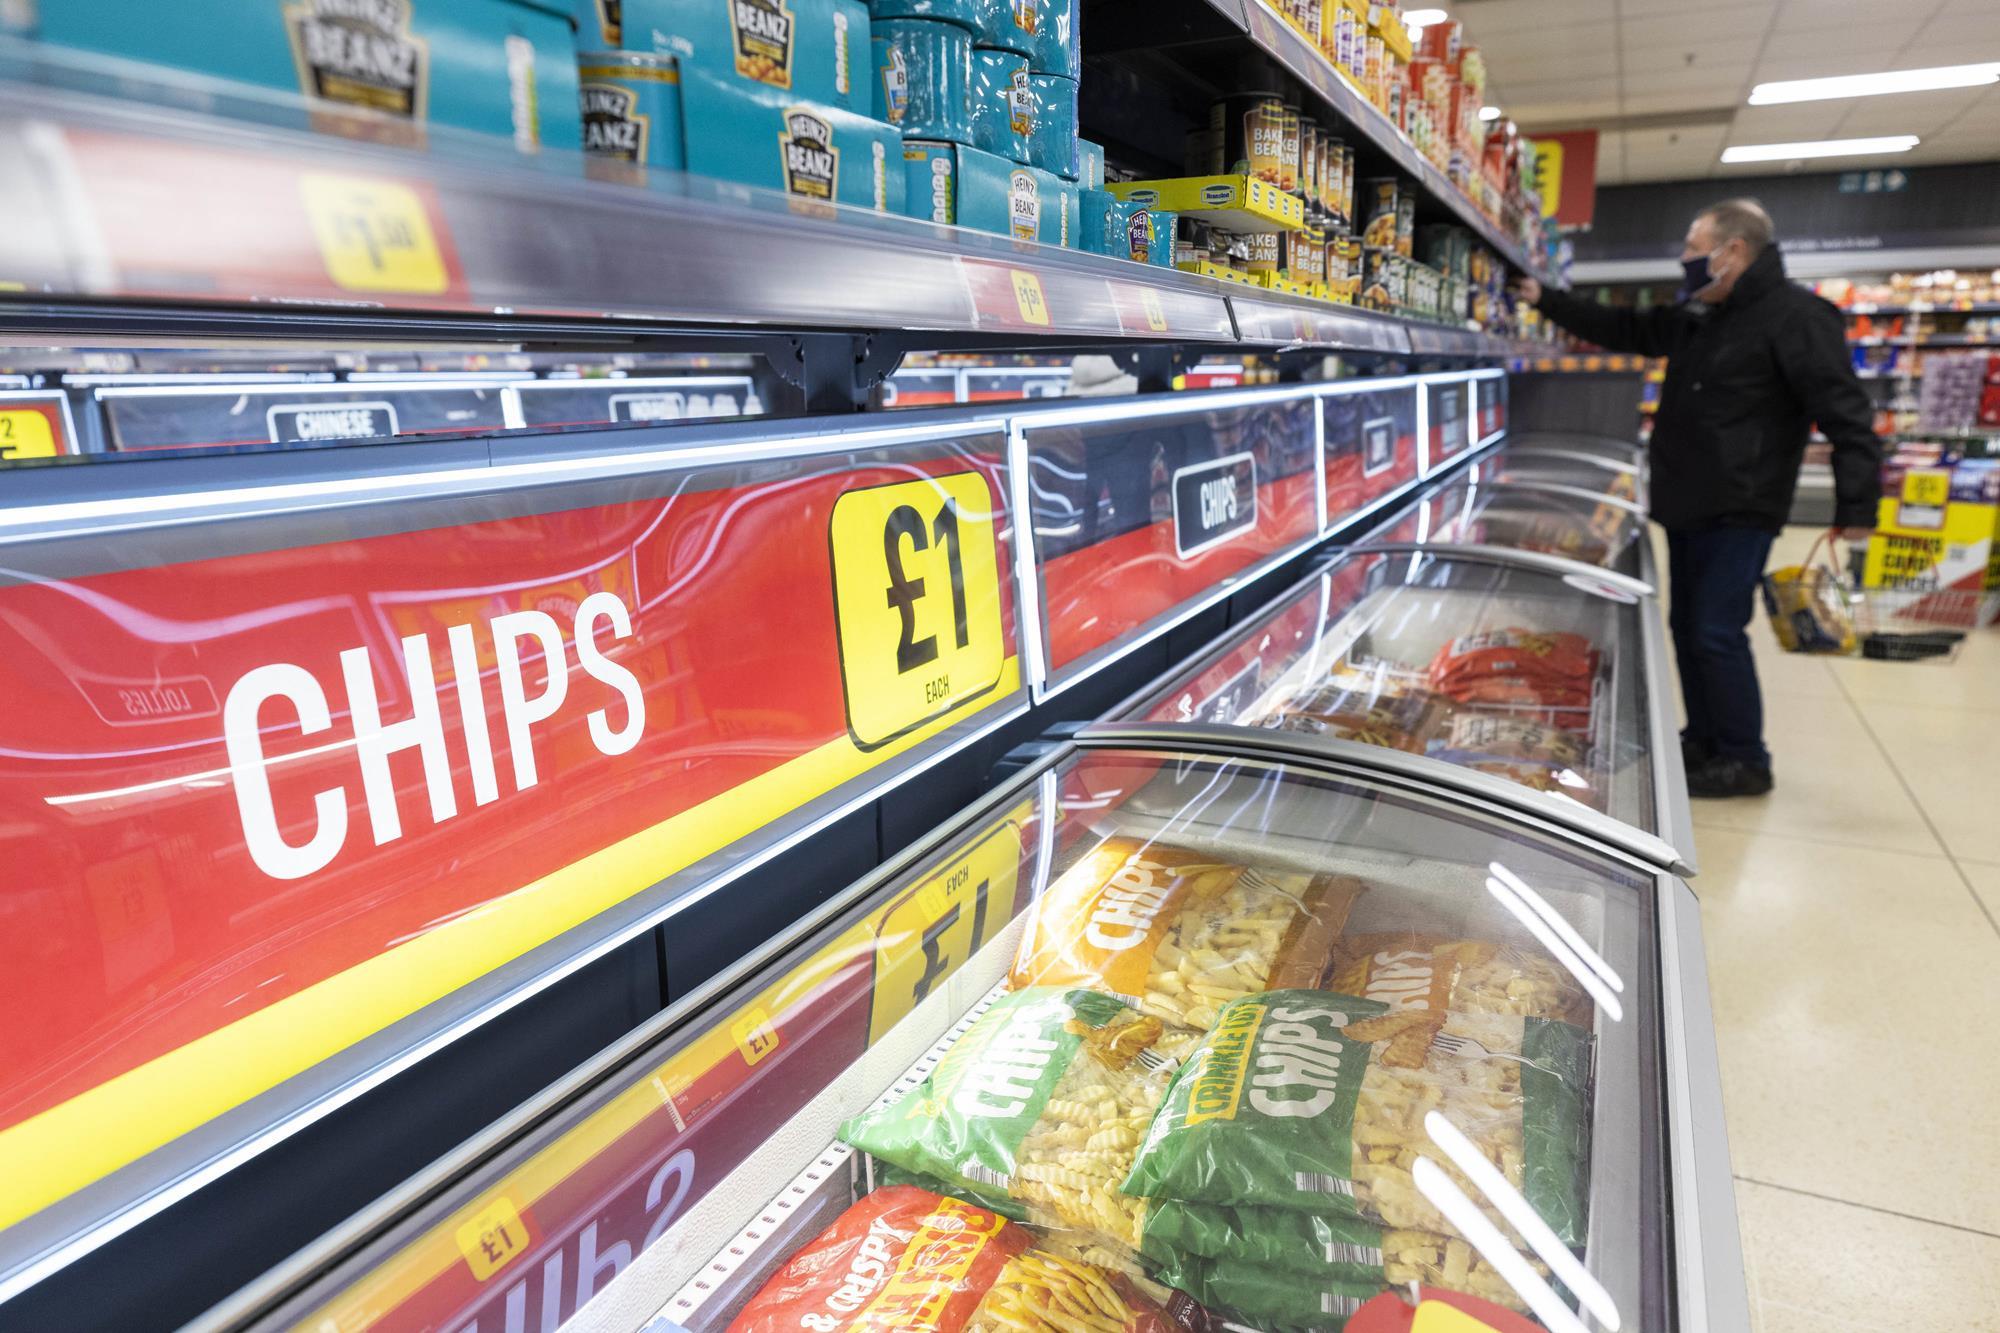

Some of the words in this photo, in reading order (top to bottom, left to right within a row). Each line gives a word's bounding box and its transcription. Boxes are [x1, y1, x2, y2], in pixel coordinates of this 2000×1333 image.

[737, 1, 787, 43] BEANZ
[788, 144, 833, 179] BEANZ
[1014, 177, 1035, 197] HEINZ
[1014, 199, 1035, 216] BEANZ
[1200, 475, 1237, 530] CHIPS
[884, 496, 969, 675] £1
[926, 675, 950, 704] EACH
[223, 591, 646, 881] CHIPS
[1249, 1007, 1349, 1118] CHIPS
[480, 1222, 514, 1264] £1
[825, 1216, 916, 1312] CRISPY
